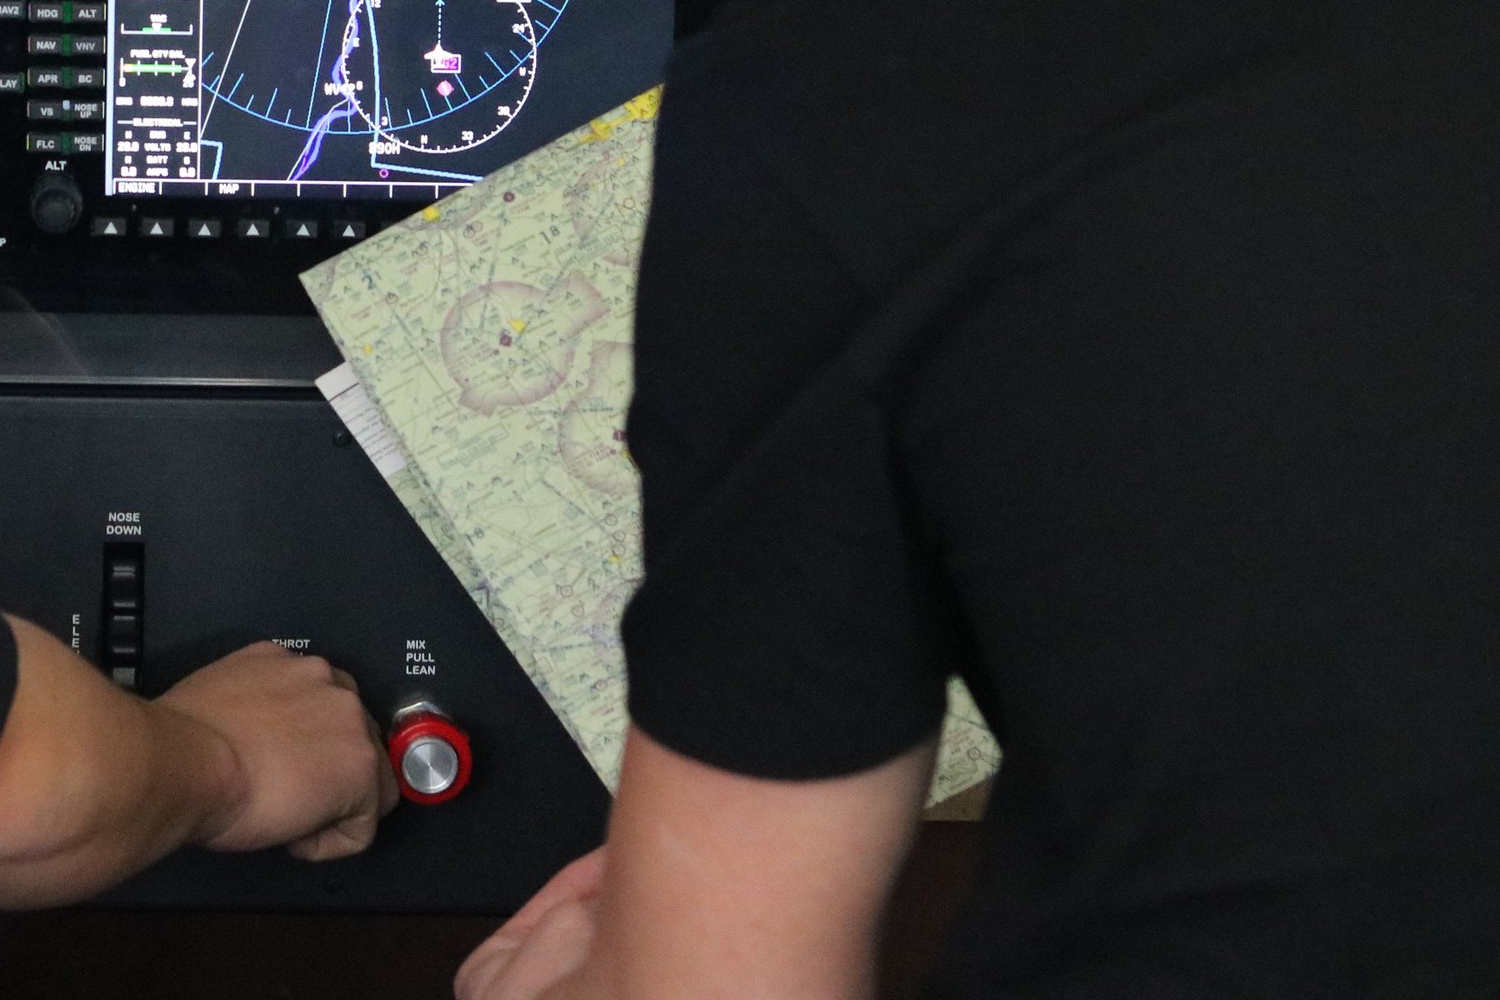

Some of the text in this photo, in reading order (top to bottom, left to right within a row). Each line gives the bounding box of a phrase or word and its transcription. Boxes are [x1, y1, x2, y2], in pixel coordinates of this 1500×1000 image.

[37, 8, 58, 19] HDG
[78, 9, 96, 18] ALT
[37, 40, 56, 50] NAV
[76, 42, 95, 51] VNV
[38, 74, 58, 84] APR
[79, 74, 92, 83] BC
[41, 107, 53, 116] VS
[75, 104, 97, 112] NOSE
[37, 139, 55, 148] FLC
[45, 161, 67, 171] ALT
[108, 512, 140, 523] NOSE
[106, 525, 142, 536] DOWN
[406, 640, 426, 649] MIX
[406, 653, 435, 663] PULL
[406, 666, 436, 676] LEAN
